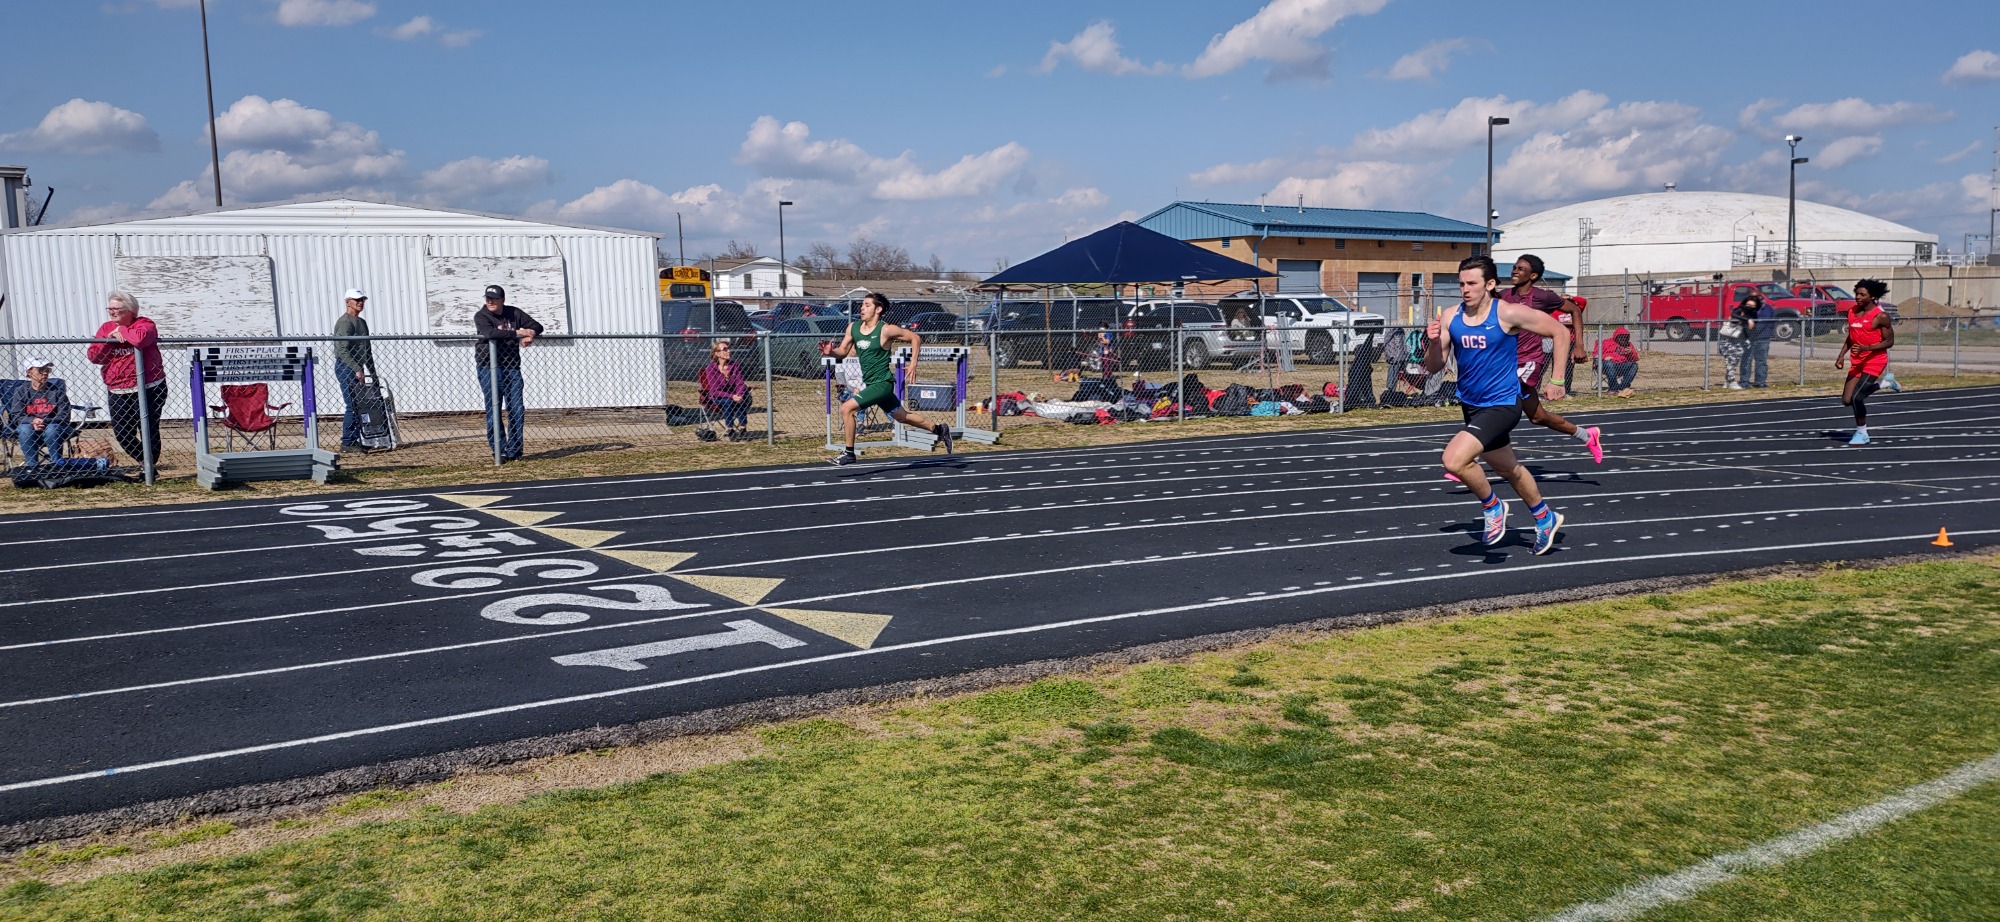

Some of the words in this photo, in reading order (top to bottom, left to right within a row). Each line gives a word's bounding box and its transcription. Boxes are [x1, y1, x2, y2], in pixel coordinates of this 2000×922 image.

[1461, 335, 1486, 349] OCS
[279, 499, 429, 516] 6
[306, 516, 480, 540] 5
[411, 558, 599, 589] 3
[480, 583, 712, 626] 2
[551, 619, 808, 671] 1
